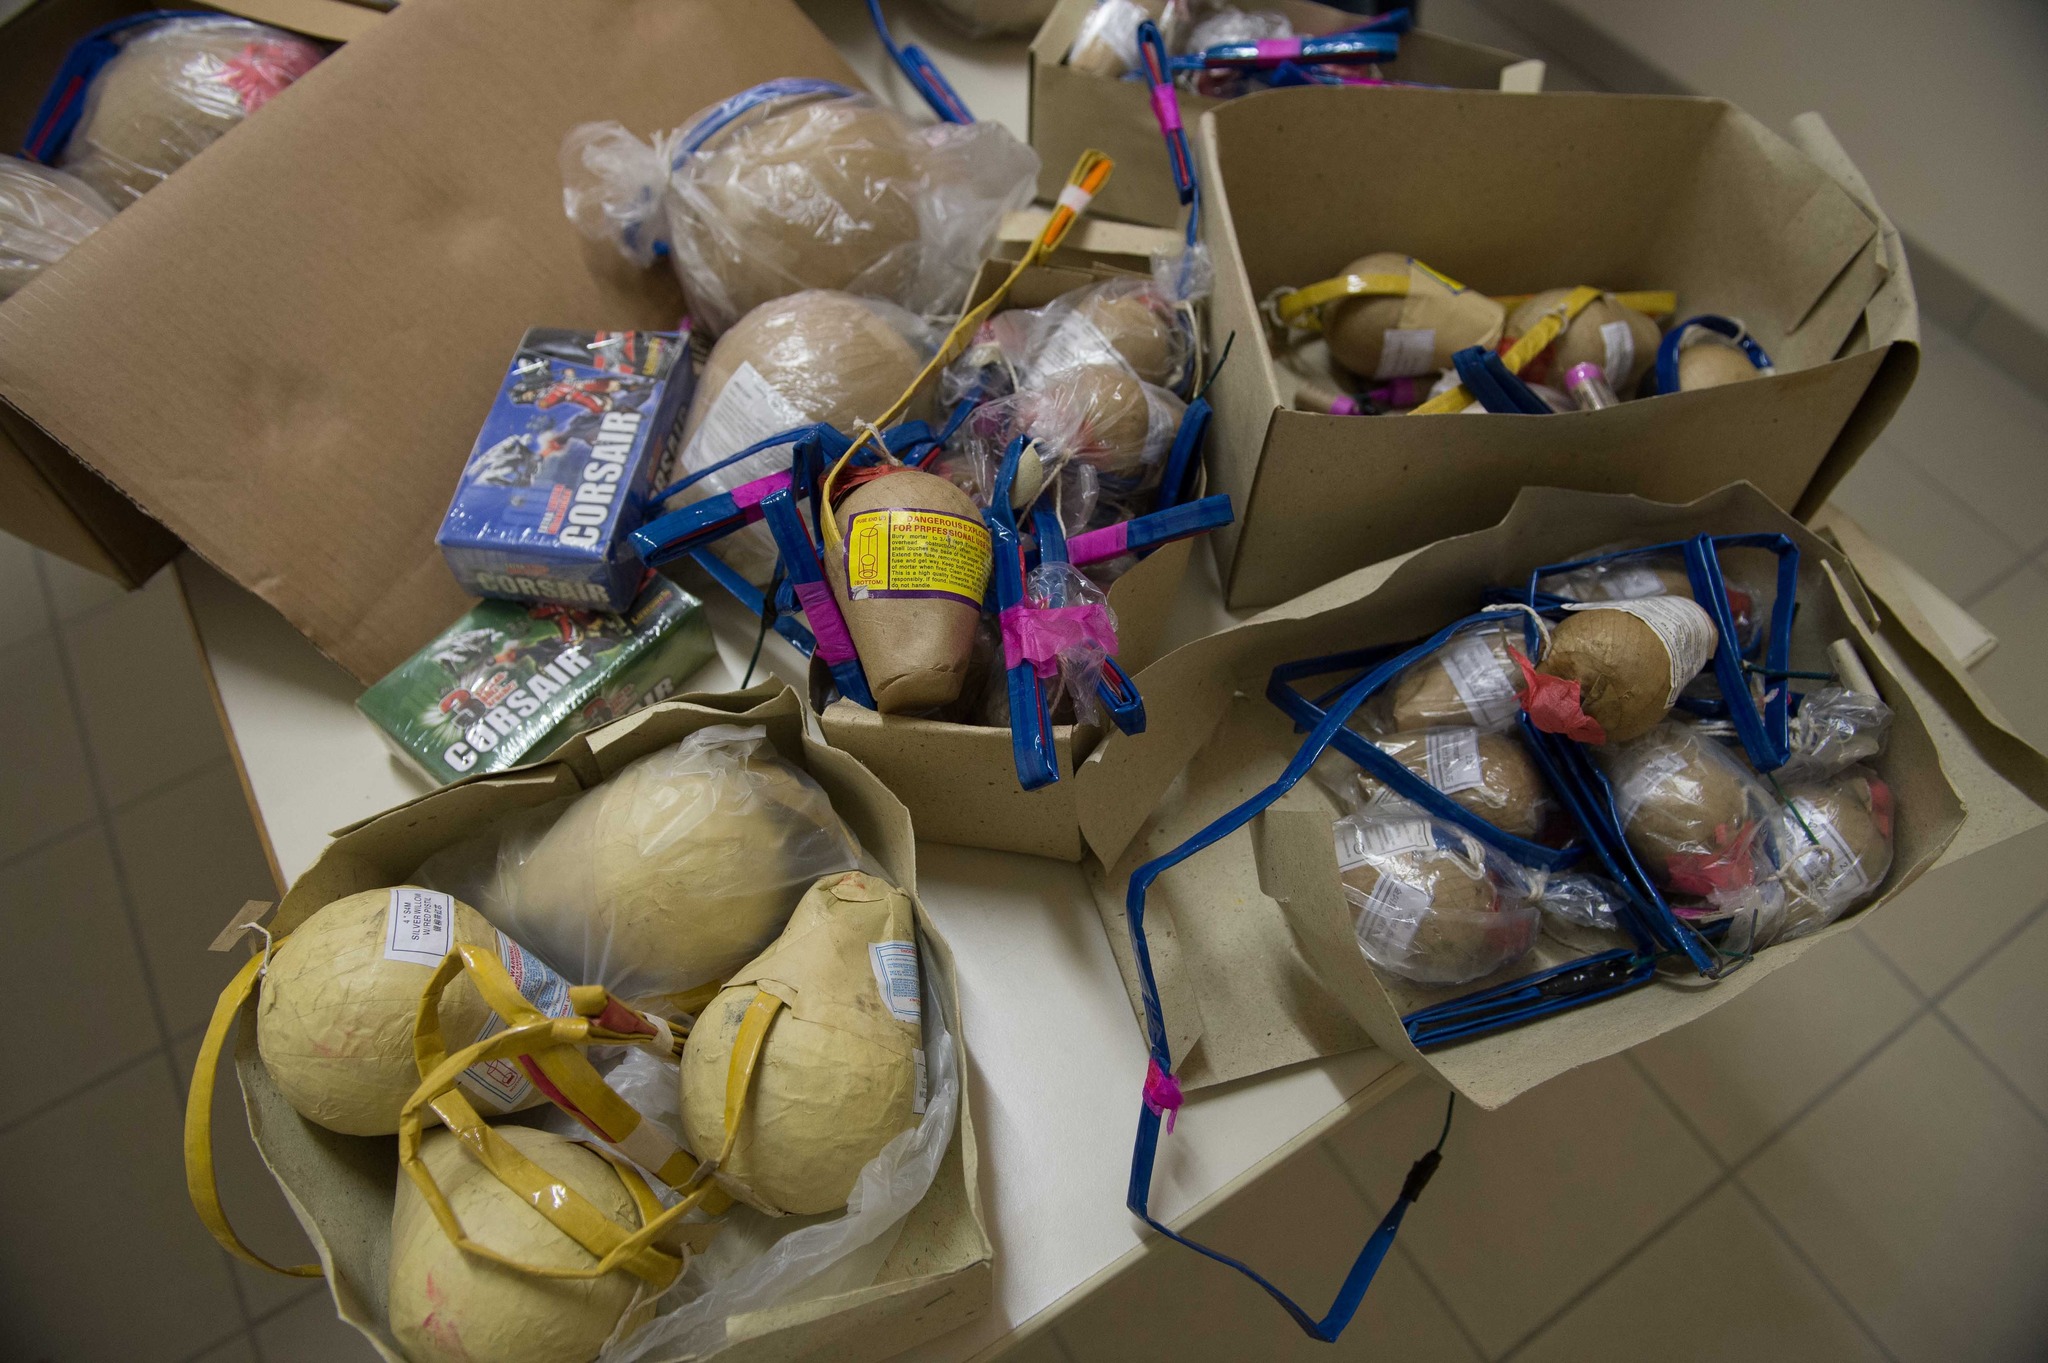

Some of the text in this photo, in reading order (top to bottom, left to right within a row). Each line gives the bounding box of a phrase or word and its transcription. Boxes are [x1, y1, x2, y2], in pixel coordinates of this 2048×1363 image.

[559, 409, 642, 548] CORSAIR
[907, 515, 962, 529] DANGEROUS
[477, 571, 609, 602] CORSAIR
[443, 646, 592, 772] CORSAIR
[412, 915, 421, 940] SILVER
